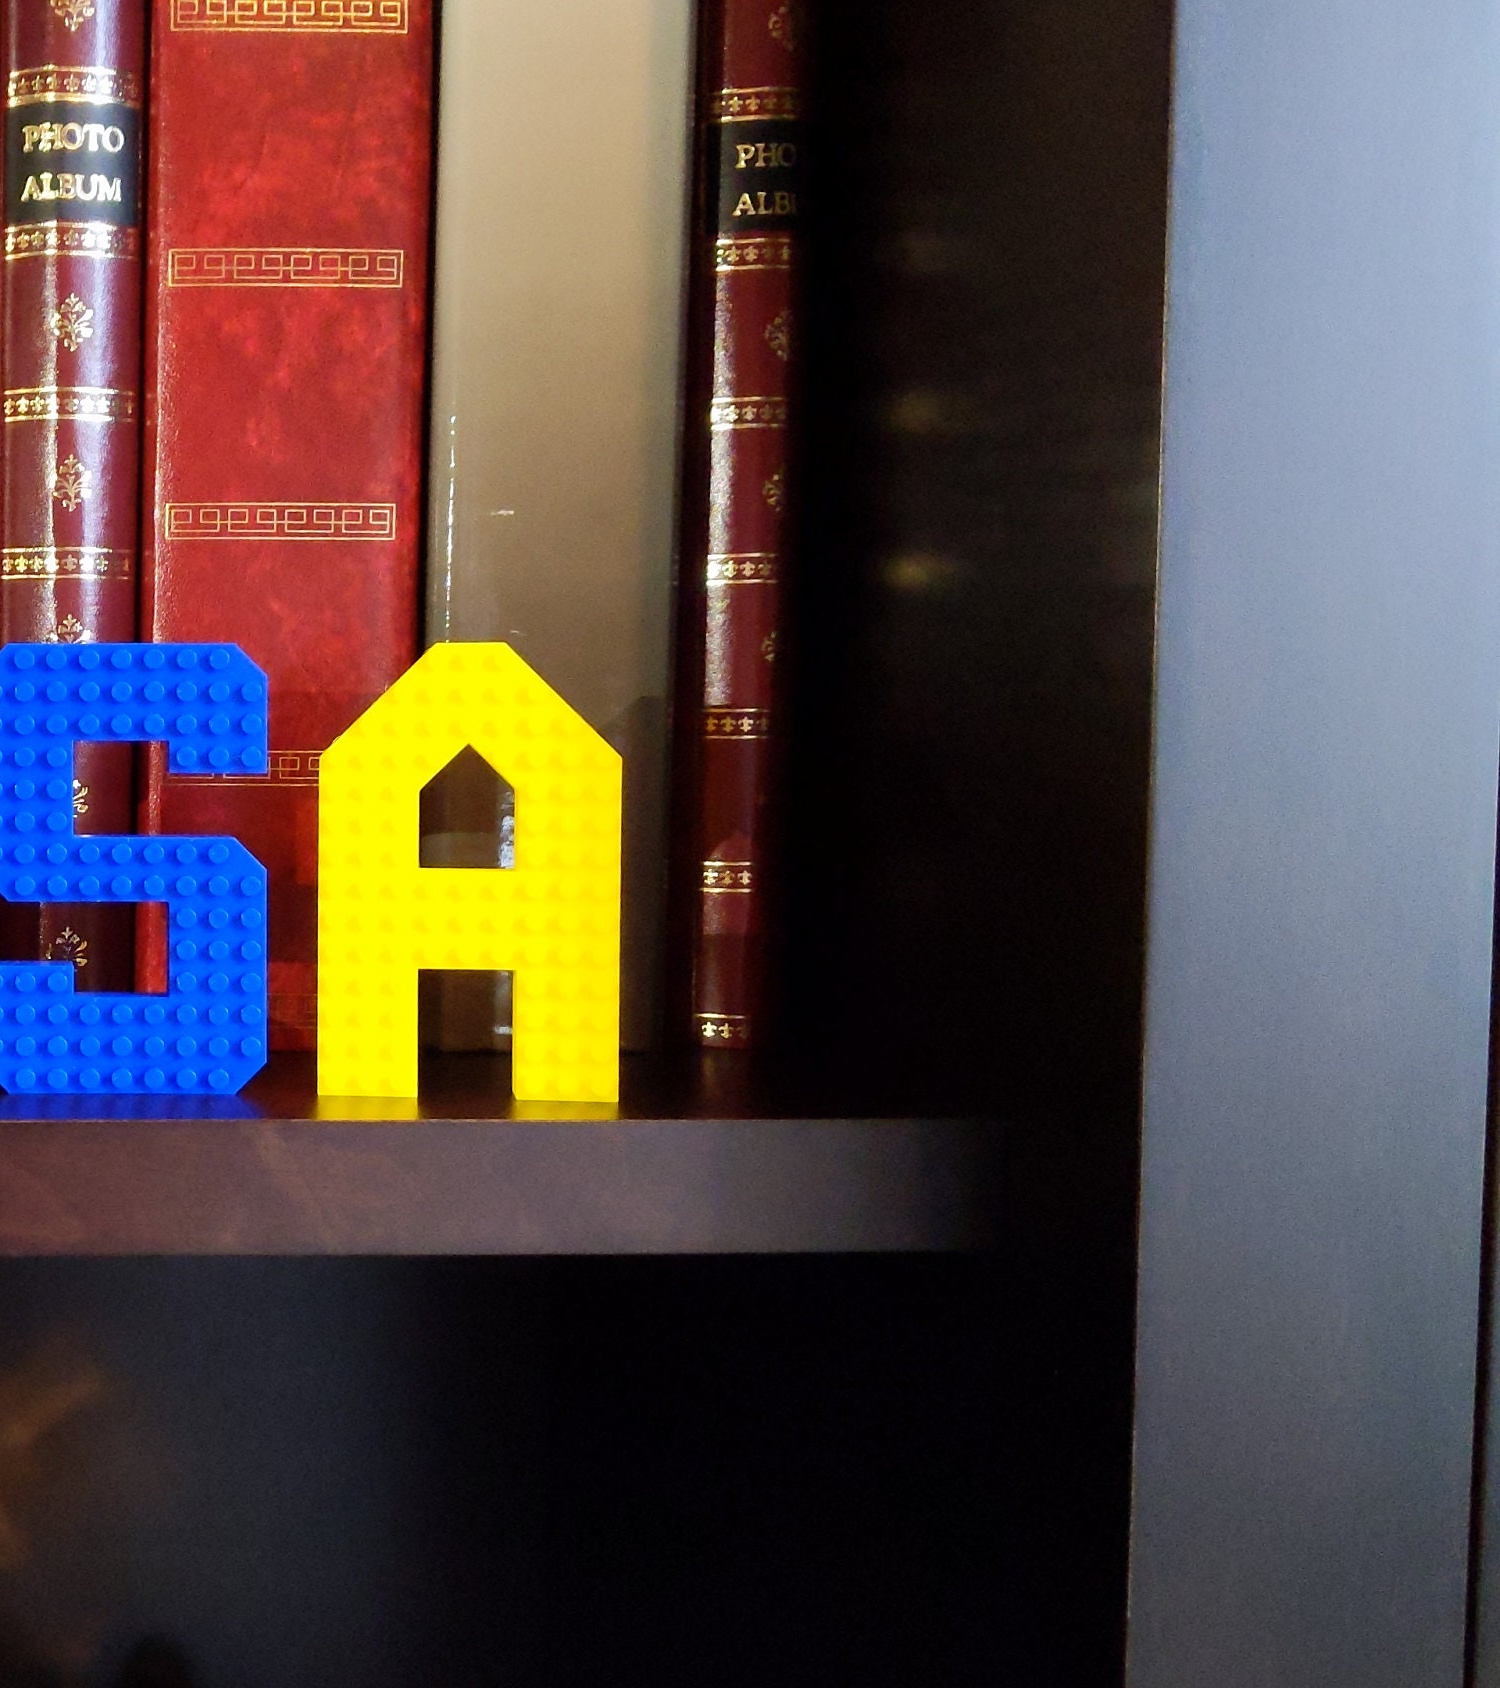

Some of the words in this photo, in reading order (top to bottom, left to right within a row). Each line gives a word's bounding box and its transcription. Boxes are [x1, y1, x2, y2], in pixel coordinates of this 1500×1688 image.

[22, 121, 125, 153] PHOTO
[21, 172, 122, 202] ALBUM
[731, 191, 797, 217] ALB
